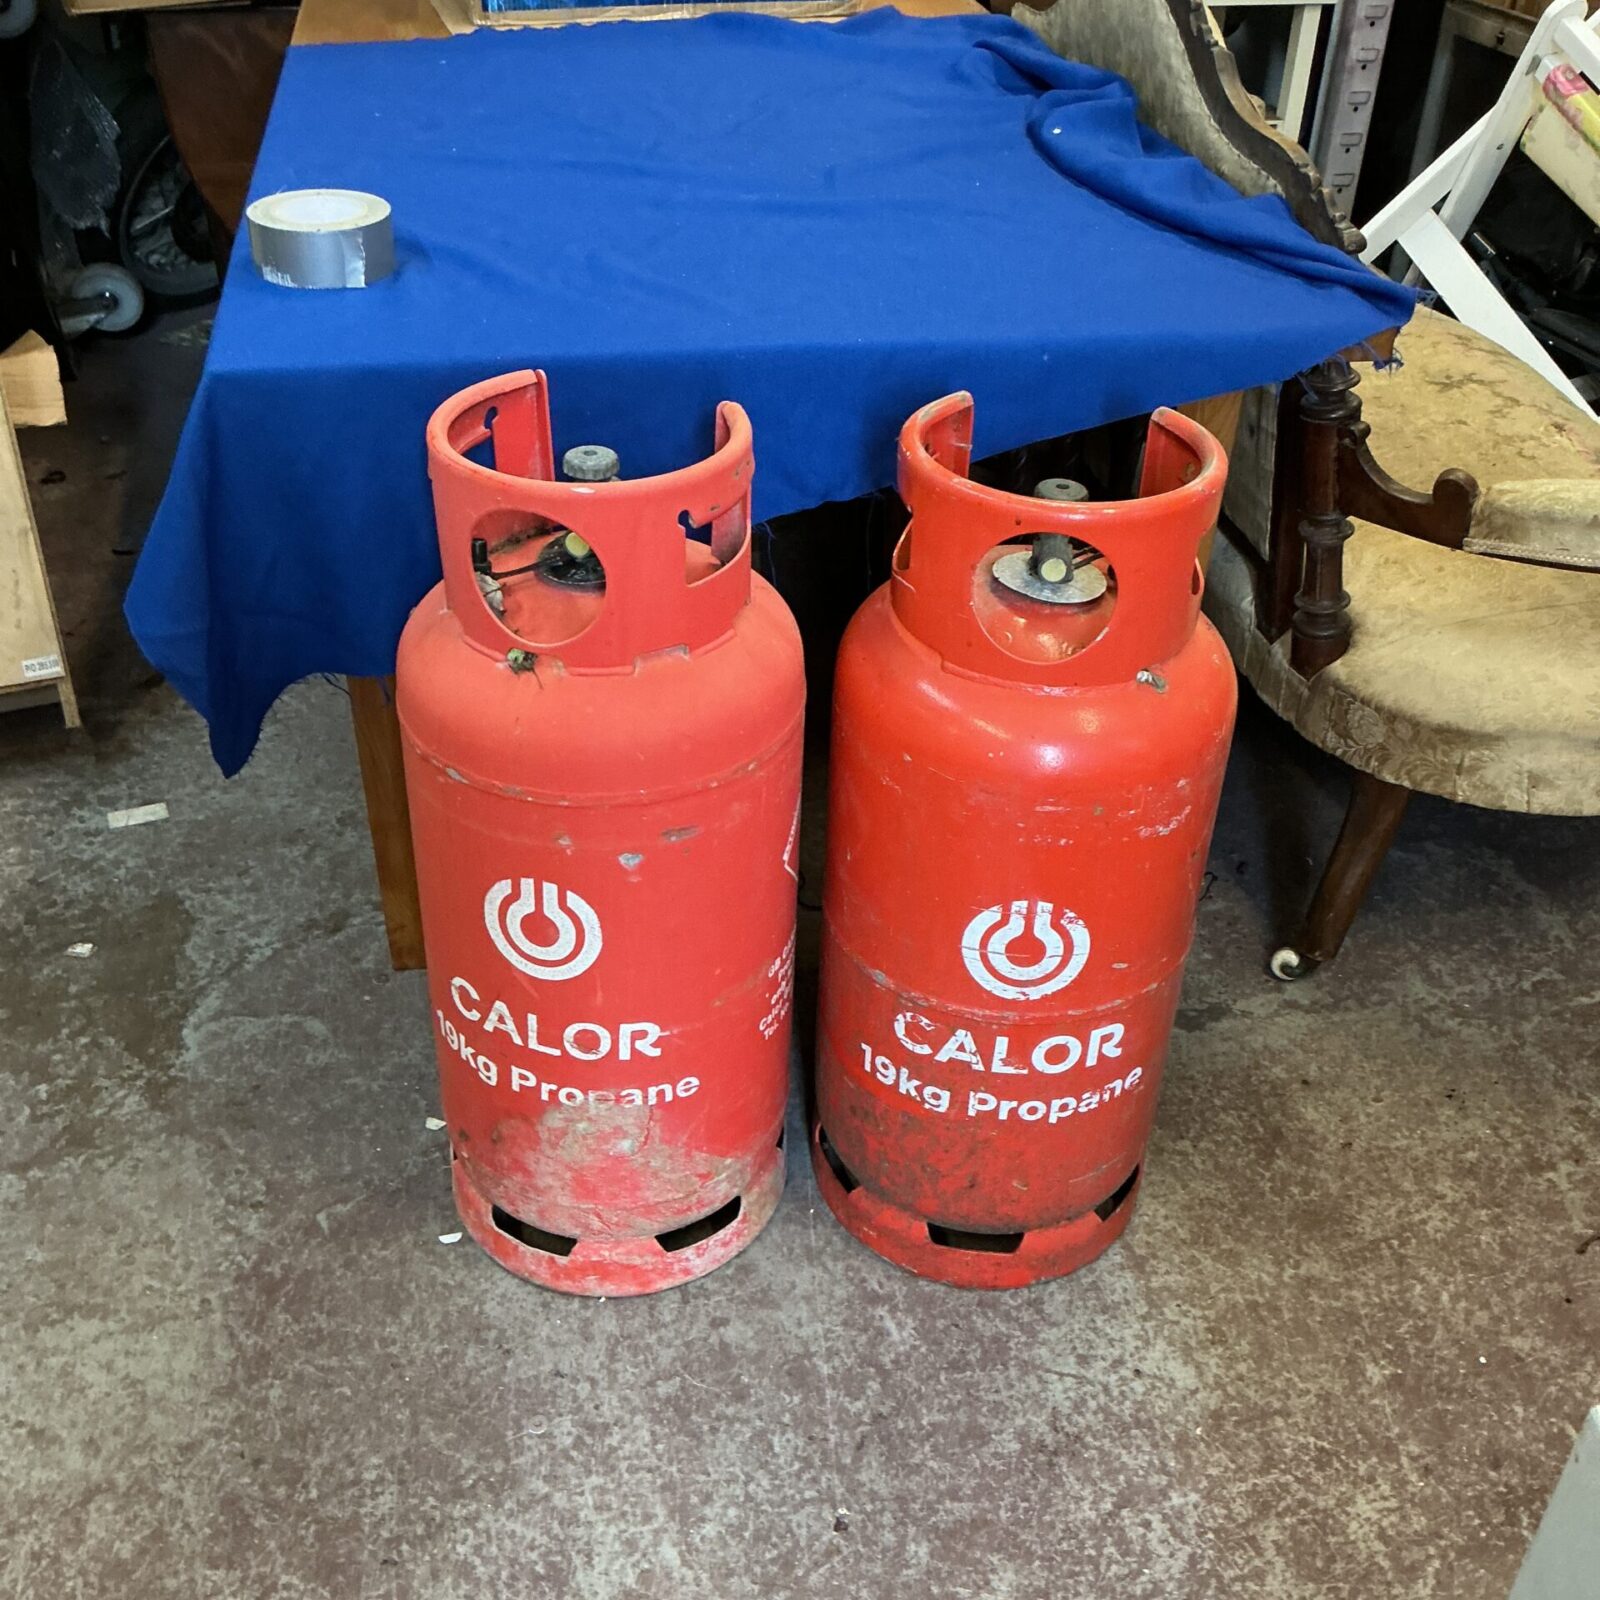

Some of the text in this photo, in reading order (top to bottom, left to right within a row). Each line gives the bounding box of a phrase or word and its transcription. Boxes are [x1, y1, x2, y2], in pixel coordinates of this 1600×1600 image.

[436, 1009, 701, 1110] 19kg Propane
[450, 975, 662, 1061] CALOR
[894, 1011, 1125, 1075] CALOR
[861, 1042, 1143, 1124] 19kg Propane
